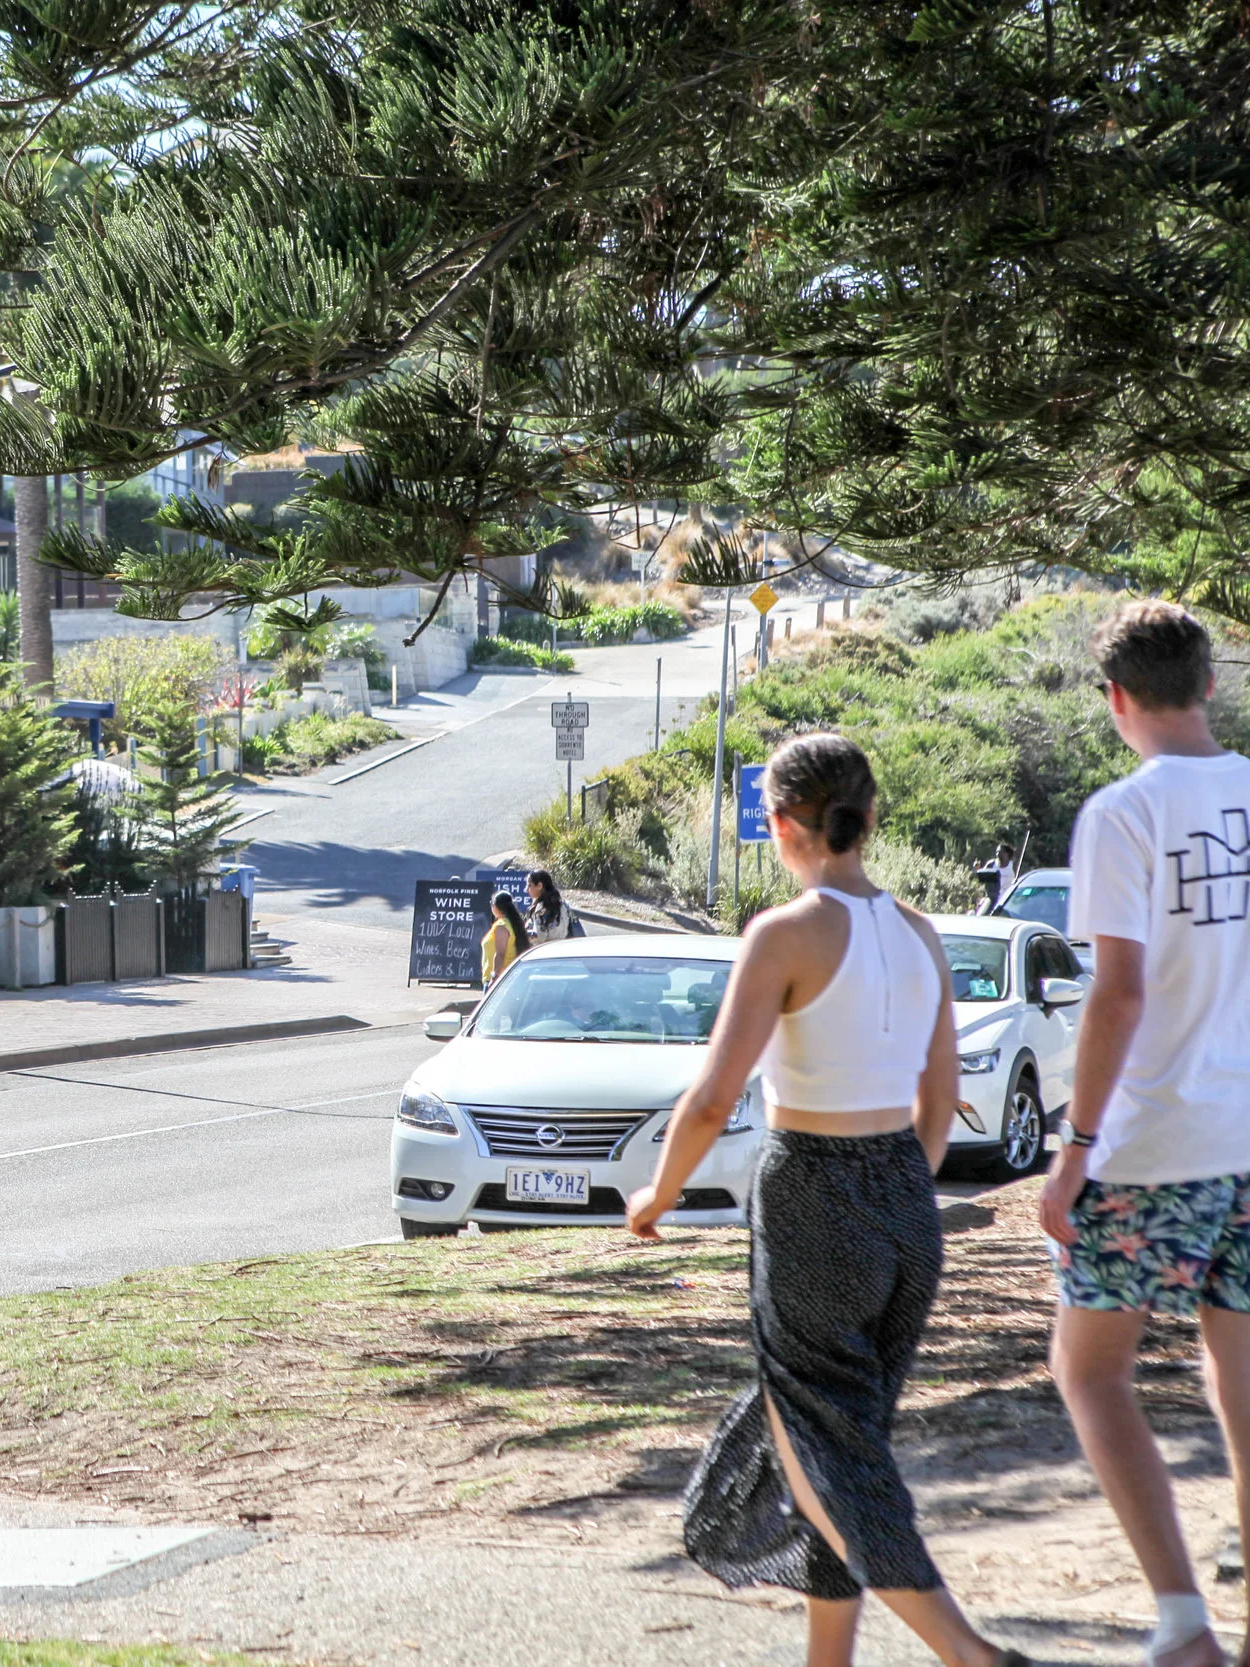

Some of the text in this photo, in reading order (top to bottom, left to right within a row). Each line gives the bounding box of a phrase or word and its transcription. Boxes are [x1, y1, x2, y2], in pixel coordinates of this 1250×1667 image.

[555, 711, 586, 719] THROUGH
[429, 887, 459, 895] NORFOLK
[494, 884, 520, 893] ISH
[434, 897, 471, 908] WINE
[430, 911, 474, 921] STORE
[418, 921, 475, 940] 100% Local
[446, 940, 470, 960] Beers
[416, 960, 442, 976] Ciders
[445, 962, 454, 976] &
